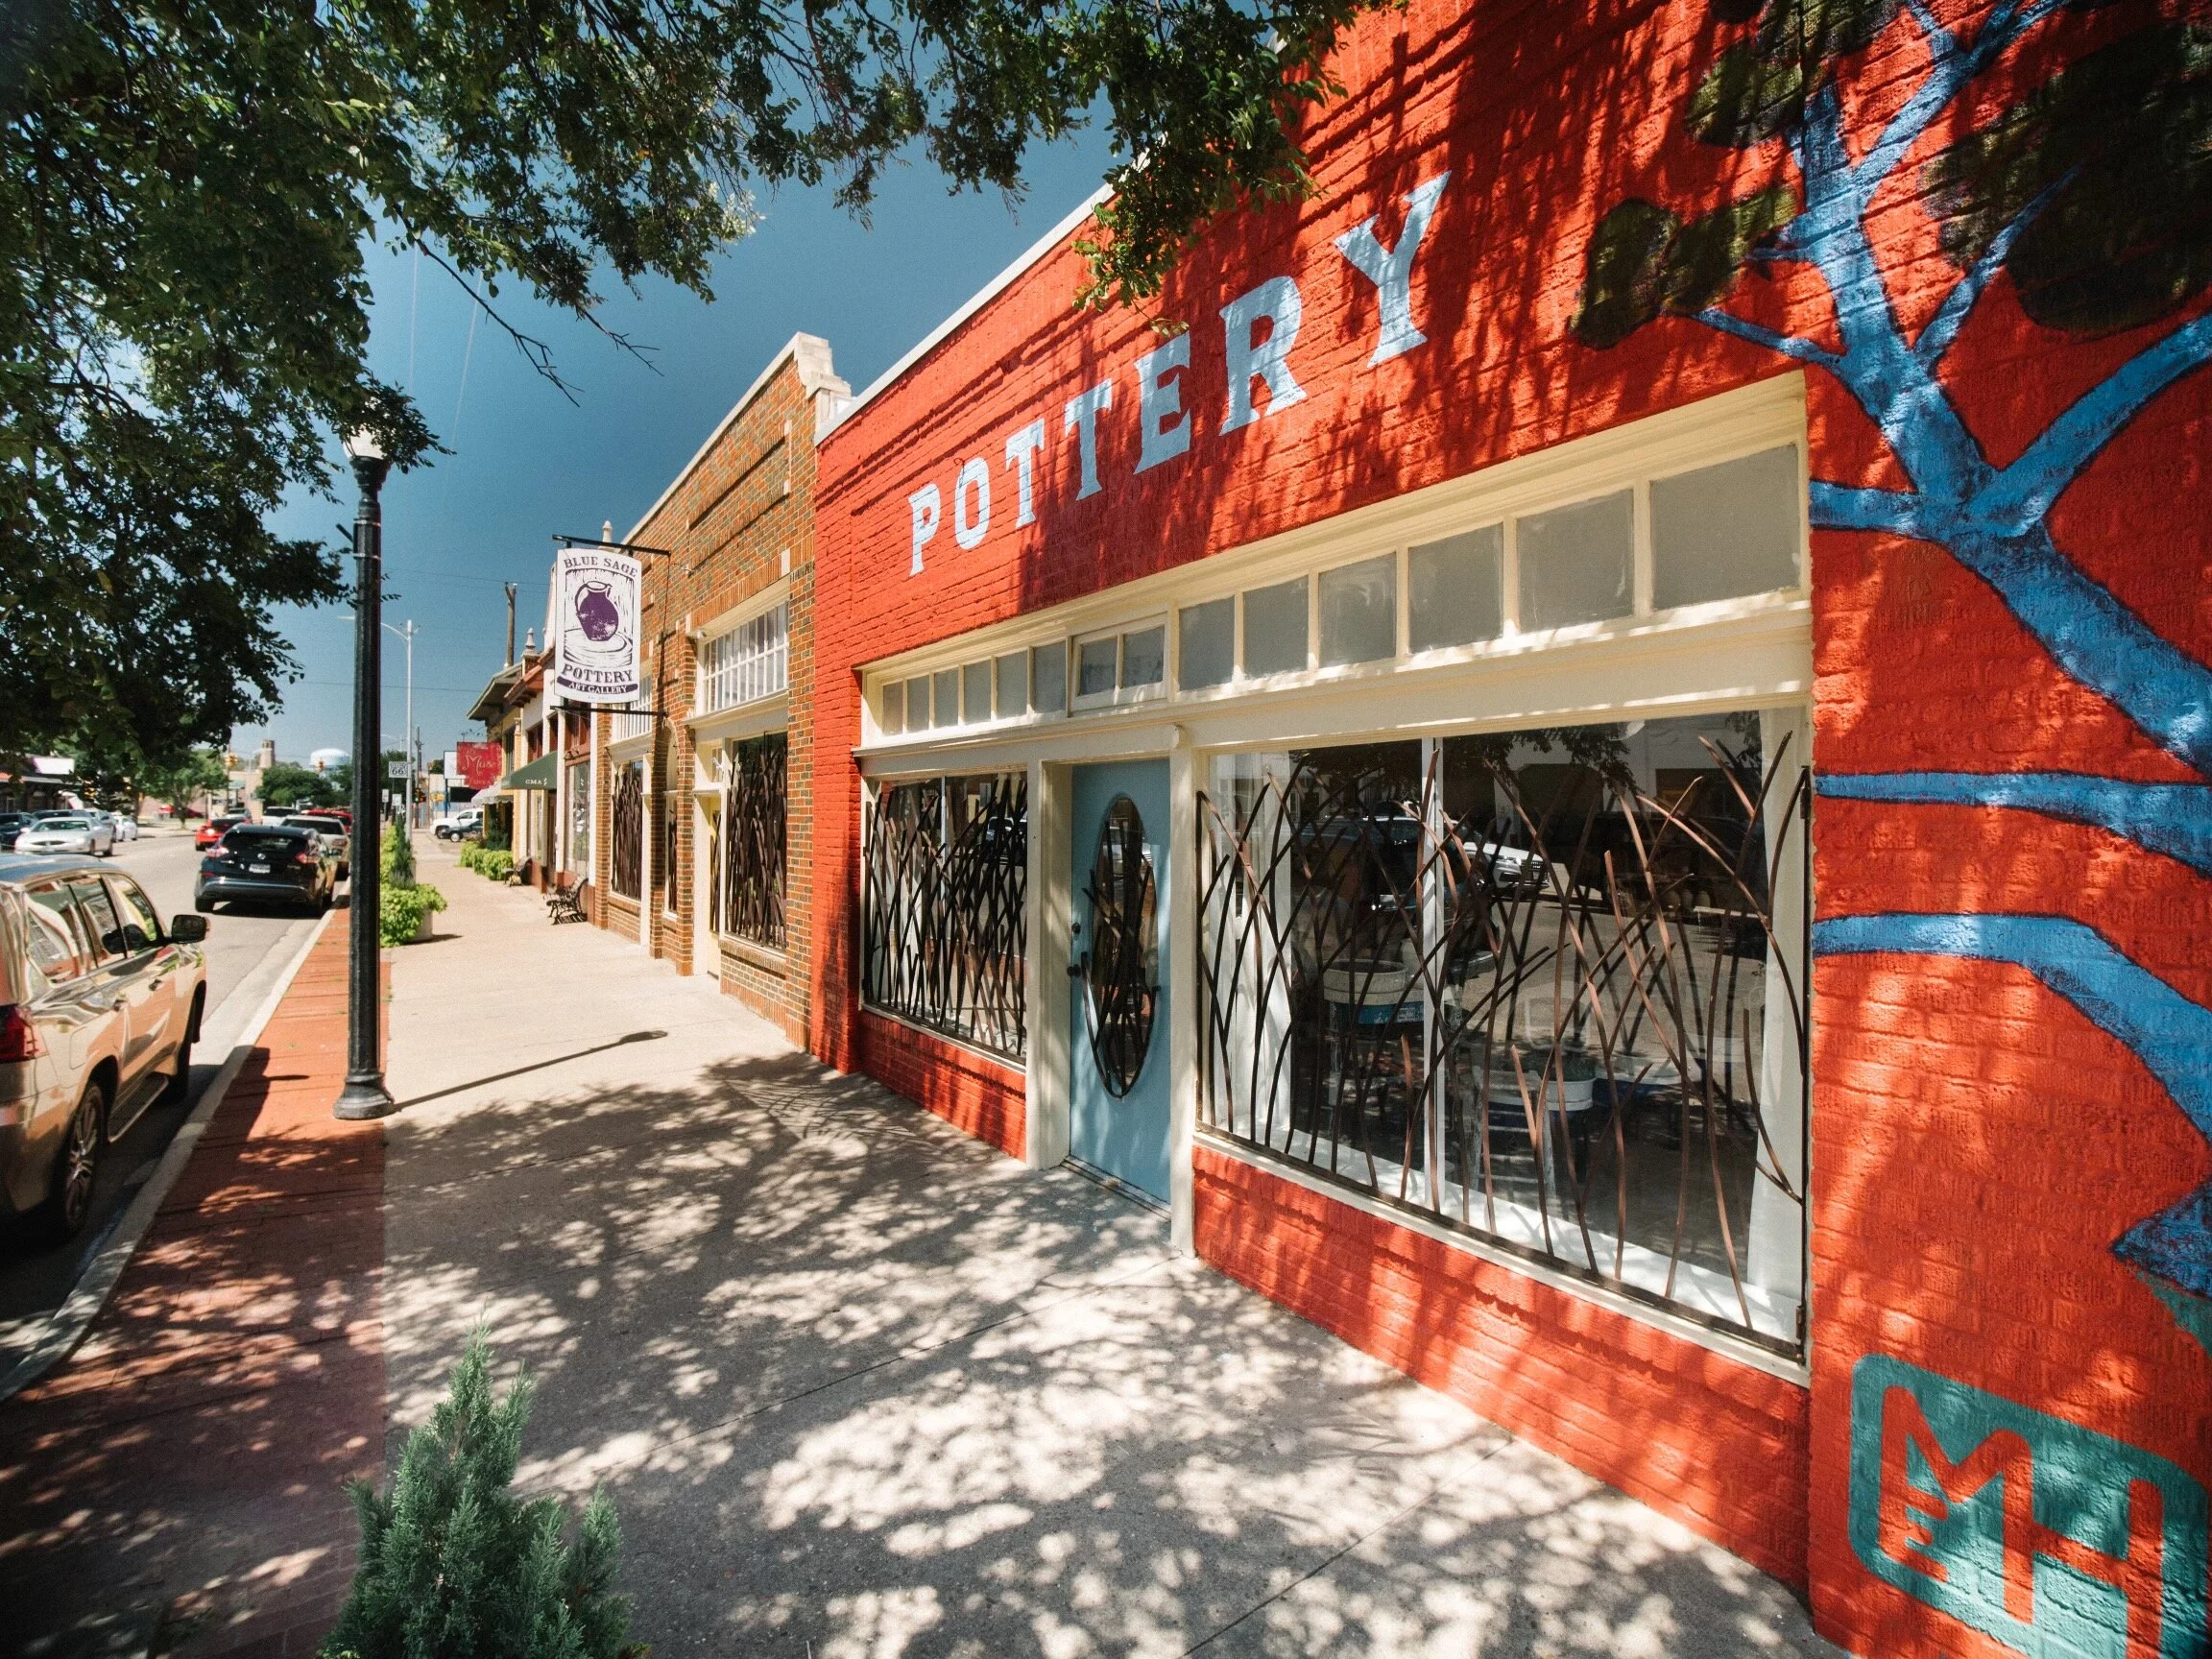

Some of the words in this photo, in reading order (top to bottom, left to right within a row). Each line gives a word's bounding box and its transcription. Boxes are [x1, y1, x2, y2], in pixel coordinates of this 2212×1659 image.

[907, 171, 1453, 578] POTTERY
[564, 557, 598, 568] BLUE
[604, 558, 637, 577] SAGE
[562, 663, 633, 683] POTTERY
[568, 683, 587, 691] ART
[588, 685, 627, 694] GALLERY
